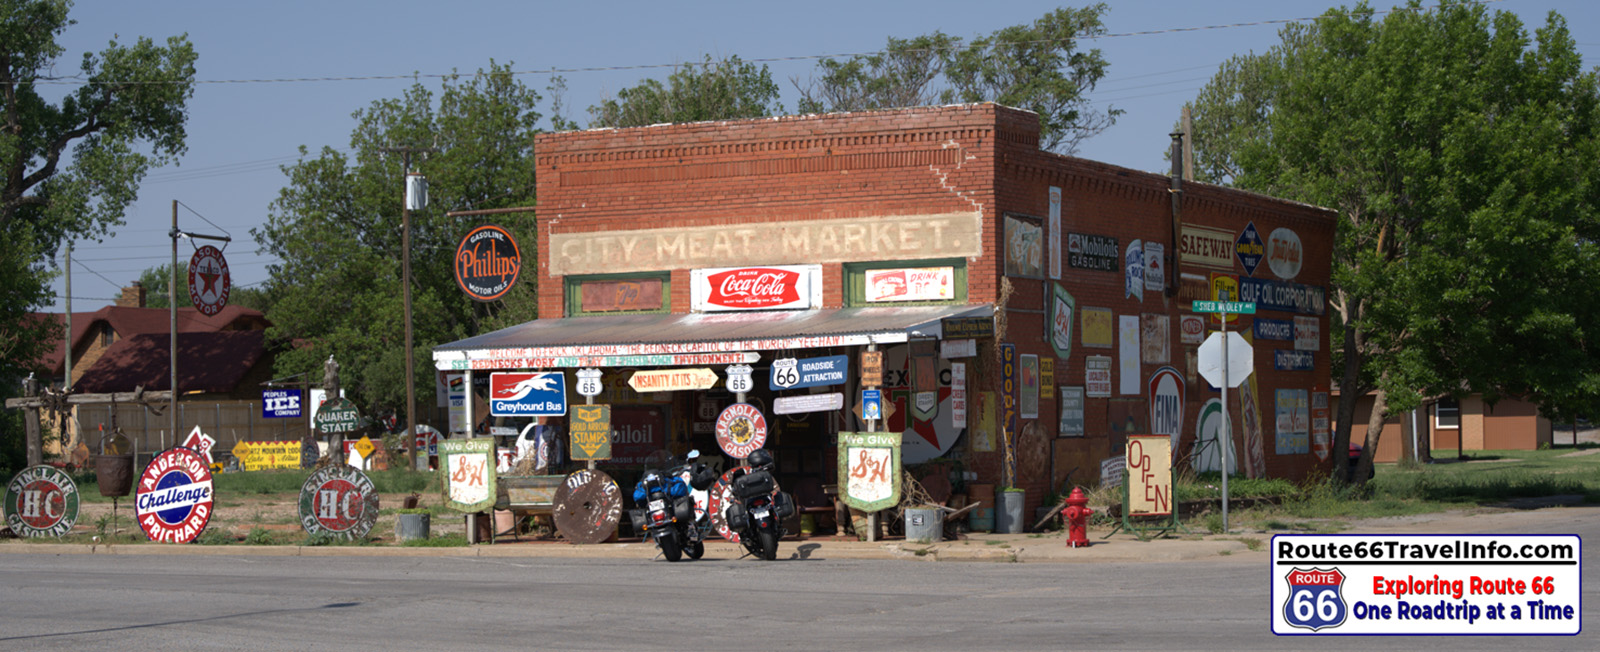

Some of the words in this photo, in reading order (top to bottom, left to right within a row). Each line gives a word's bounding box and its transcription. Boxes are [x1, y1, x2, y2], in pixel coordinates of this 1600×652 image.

[470, 231, 504, 243] GASOLINE
[561, 237, 640, 262] CITY
[656, 230, 754, 260] MEAT
[1081, 236, 1118, 258] Mobiloils
[1181, 234, 1233, 260] SAFEWAY
[190, 247, 227, 275] GASOLINE
[460, 239, 516, 283] Phillips
[1071, 256, 1111, 271] GASOLINE
[1244, 257, 1256, 267] TIRES
[910, 272, 939, 283] DRINK
[469, 283, 492, 295] MOTOR
[493, 281, 508, 293] OILS
[190, 284, 217, 314] MOTOR
[219, 286, 229, 306] OIL
[1241, 283, 1260, 303] GULF
[1262, 283, 1274, 304] OIL
[1275, 287, 1325, 311] CORPORATION
[1199, 302, 1216, 311] SHEB
[1218, 303, 1244, 312] WOOLEY
[1259, 322, 1291, 337] PRODUCTS
[489, 348, 527, 358] WELCOME
[532, 347, 542, 358] TO
[572, 344, 617, 356] OKLAHOMA
[644, 343, 682, 354] REDNECK
[686, 342, 716, 353] CAPITOL
[724, 341, 734, 351] OF
[739, 340, 755, 350] THE
[451, 359, 469, 370] SEE
[472, 358, 523, 369] REDNECKS
[526, 357, 555, 368] WORK
[557, 357, 578, 367] AND
[579, 355, 603, 367] PLAY
[606, 356, 617, 366] IN
[651, 355, 672, 365] OWN
[674, 353, 745, 365] ENVIRONMENT!
[802, 360, 834, 372] ROADSIDE
[1277, 353, 1313, 367] DISTRIBUTOR
[634, 374, 670, 389] INSANITY
[671, 374, 681, 387] AT
[681, 373, 691, 387] ITS
[733, 380, 746, 390] 66
[776, 368, 797, 385] 66
[803, 371, 843, 383] ATTRACTION
[583, 382, 595, 393] 66
[265, 396, 300, 411] ICE
[496, 402, 544, 413] Greyhound
[546, 402, 562, 411] Bus
[316, 411, 357, 423] QUAKER
[717, 405, 760, 438] MAGNOLIA
[1155, 394, 1179, 434] FINA
[321, 422, 354, 433] STATE
[571, 422, 587, 431] GOLD
[587, 421, 609, 431] ARROW
[609, 423, 653, 444] biloil
[444, 442, 463, 451] We
[465, 441, 490, 451] Give
[574, 431, 607, 444] STAMPS
[725, 427, 765, 457] GASOLINE
[844, 435, 864, 445] We
[866, 435, 895, 445] Give
[143, 453, 206, 490] ANDERSON
[451, 455, 486, 486] S&H
[851, 449, 889, 483] S&H
[11, 468, 74, 497] SINCLAIR
[305, 466, 372, 496] SINCLAIR
[1128, 440, 1168, 513] OPEN
[139, 486, 210, 510] Challenge
[144, 504, 208, 543] PRICHARD
